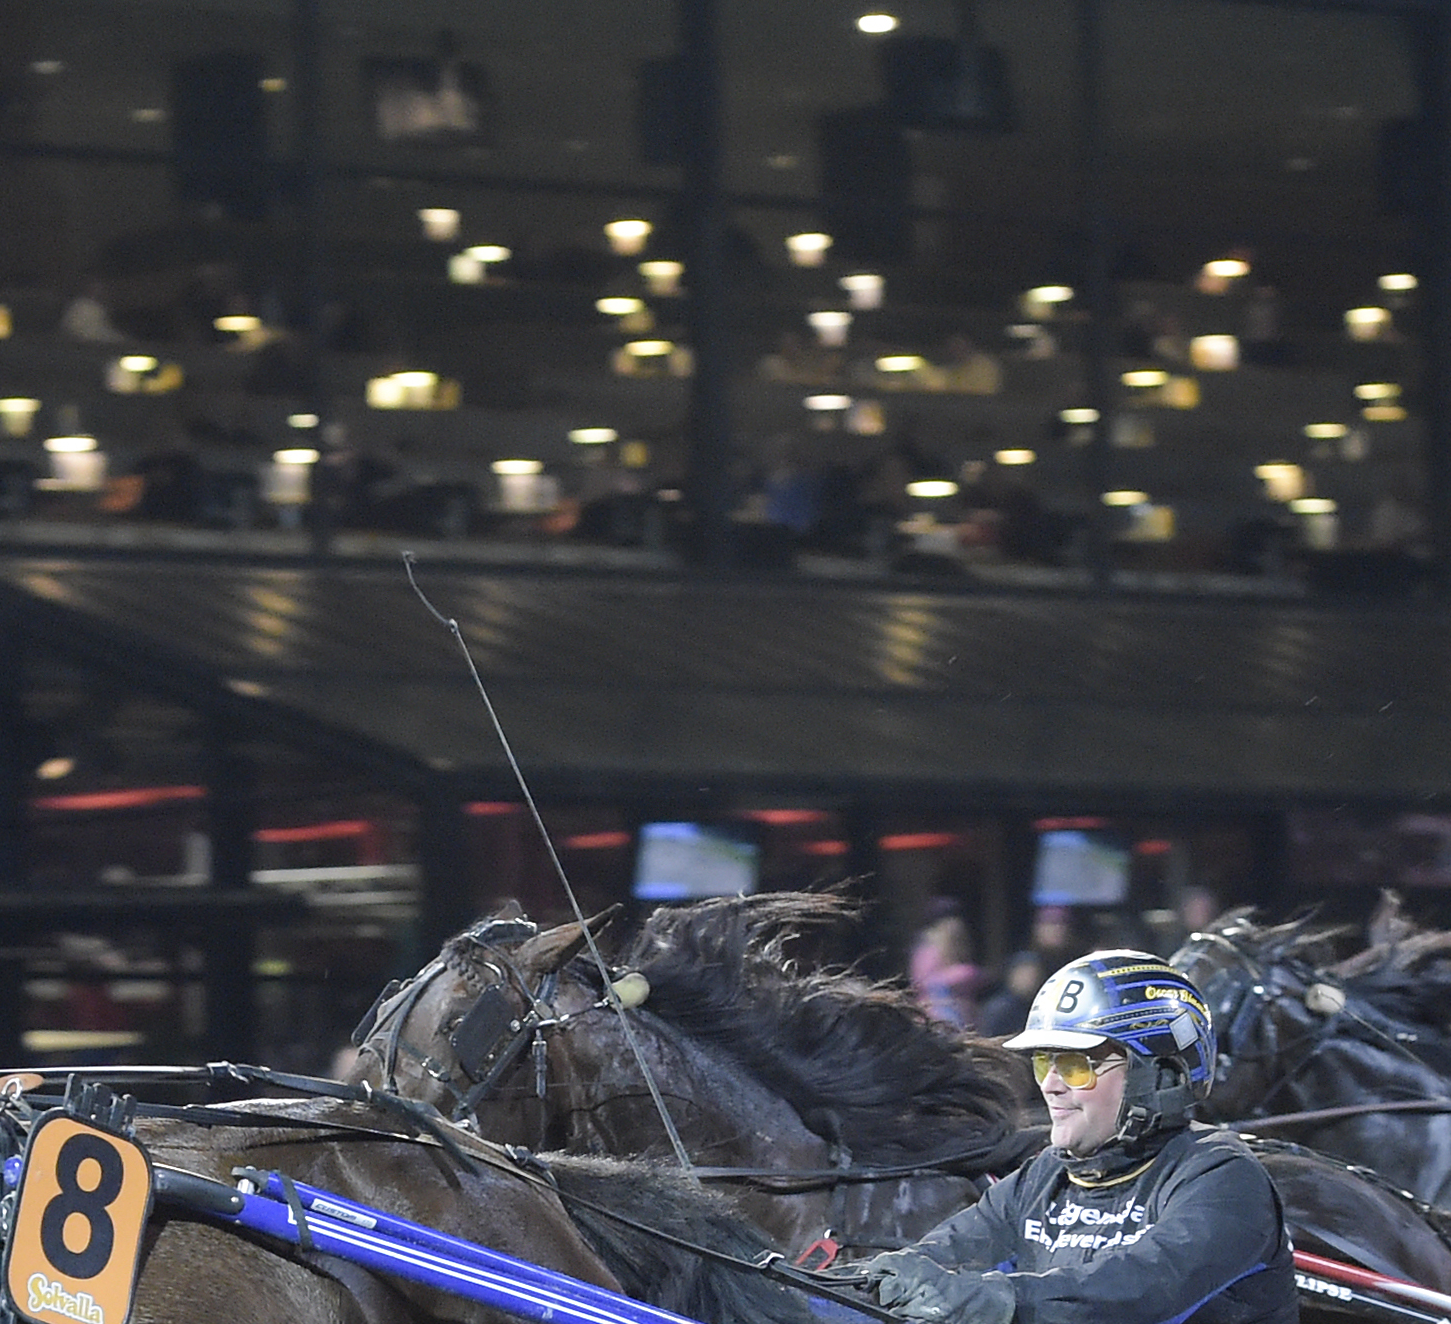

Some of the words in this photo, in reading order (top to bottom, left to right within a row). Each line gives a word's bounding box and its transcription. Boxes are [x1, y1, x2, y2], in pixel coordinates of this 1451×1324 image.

[1056, 980, 1084, 1013] B
[40, 1133, 124, 1279] 8
[1294, 1274, 1352, 1301] LIPSE
